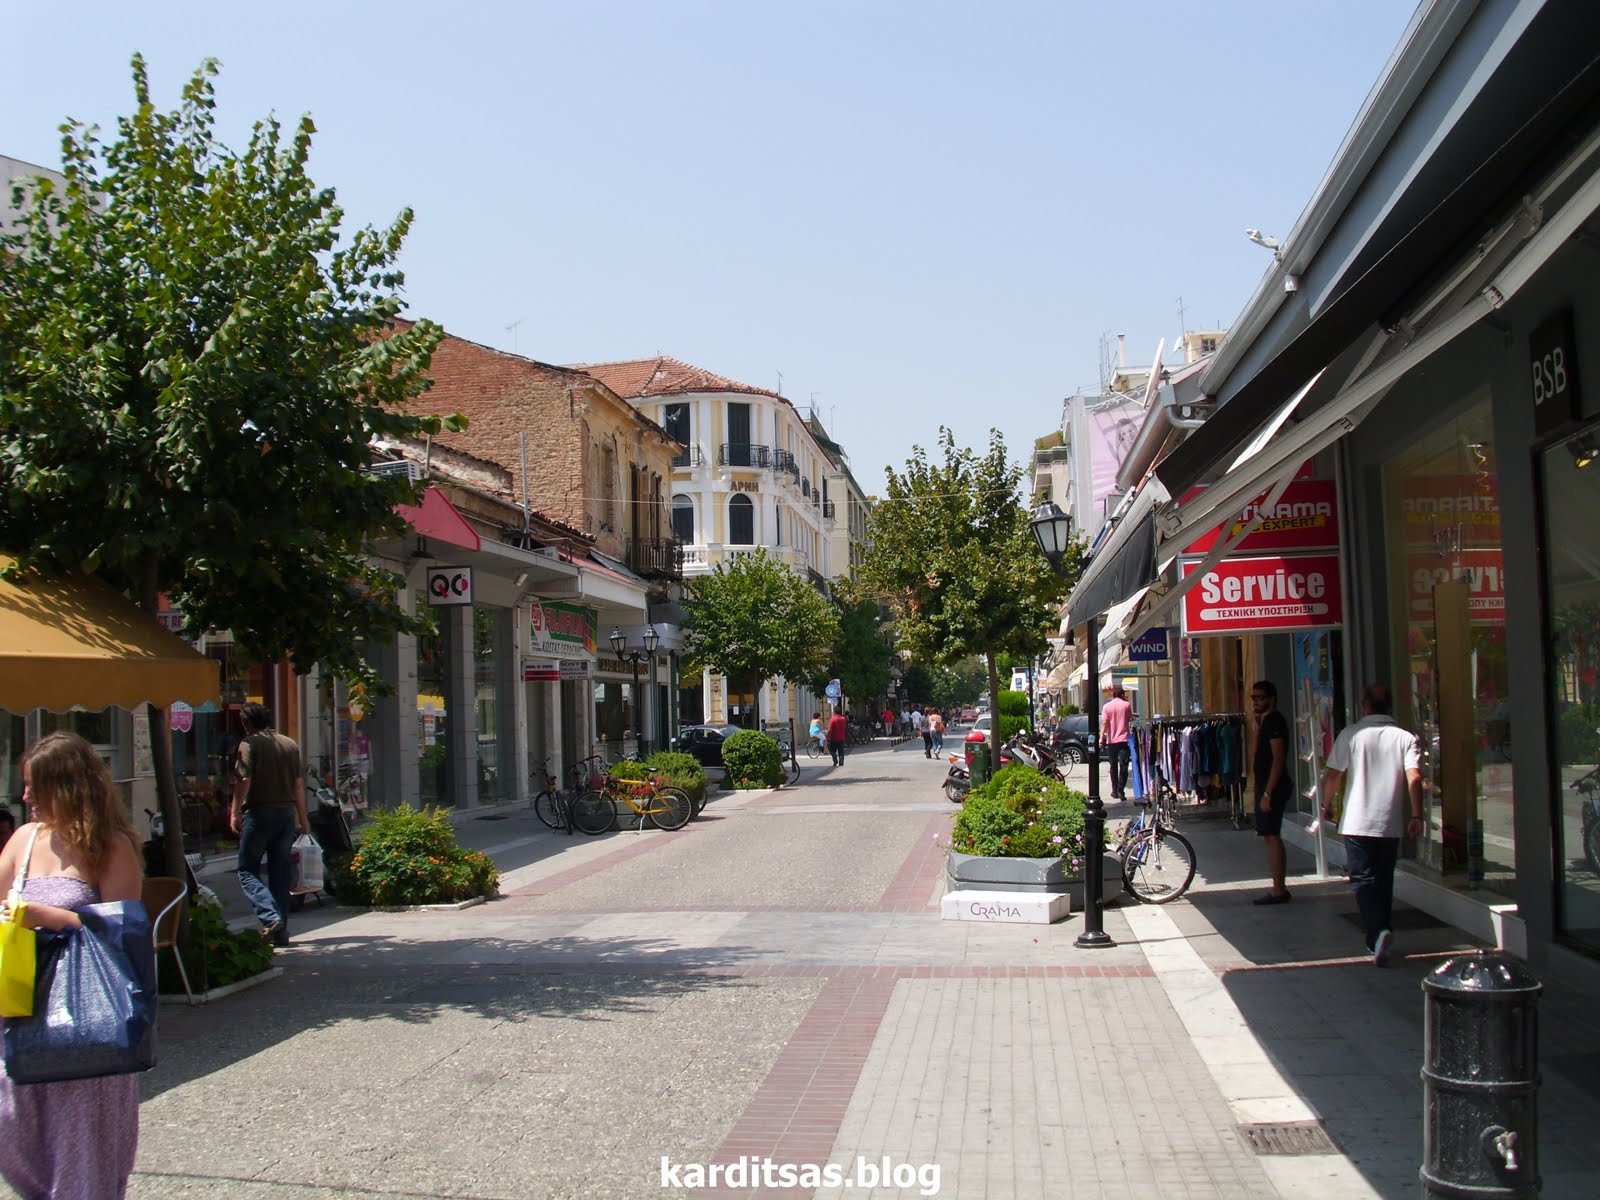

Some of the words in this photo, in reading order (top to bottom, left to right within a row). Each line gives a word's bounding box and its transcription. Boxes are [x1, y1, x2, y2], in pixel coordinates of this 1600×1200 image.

[1532, 347, 1567, 406] BSB
[1263, 517, 1316, 531] EXPERT
[1201, 569, 1325, 604] Service
[1216, 607, 1256, 618] ΤΕΧΝΙΚΗ
[1258, 605, 1314, 617] ΥΠΟΣΤΗΡΙΞΗ
[1131, 643, 1166, 653] WIND
[970, 902, 1021, 919] GRAMA
